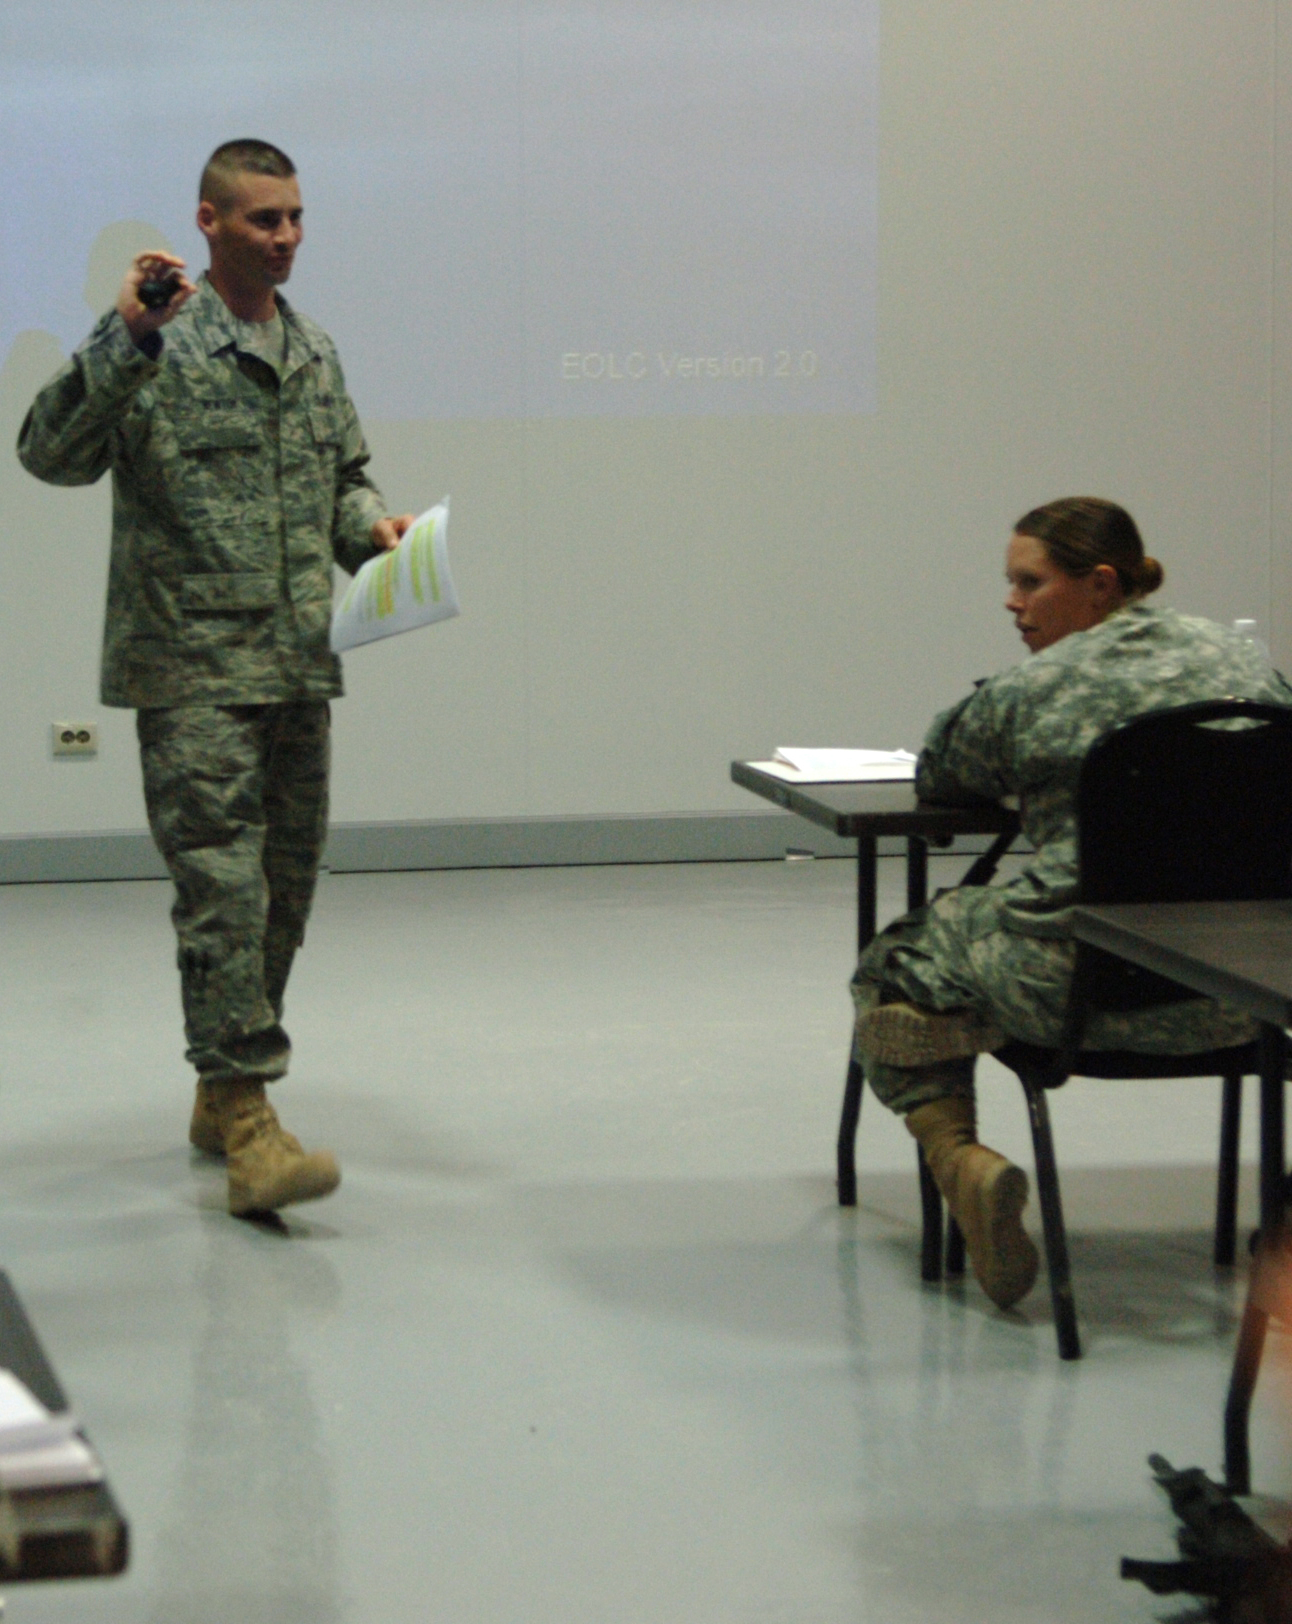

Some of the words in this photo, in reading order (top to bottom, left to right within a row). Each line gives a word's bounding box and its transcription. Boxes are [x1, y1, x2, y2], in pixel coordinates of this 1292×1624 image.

[560, 351, 648, 379] EOLC
[656, 350, 765, 378] Version
[773, 349, 818, 378] 2.0
